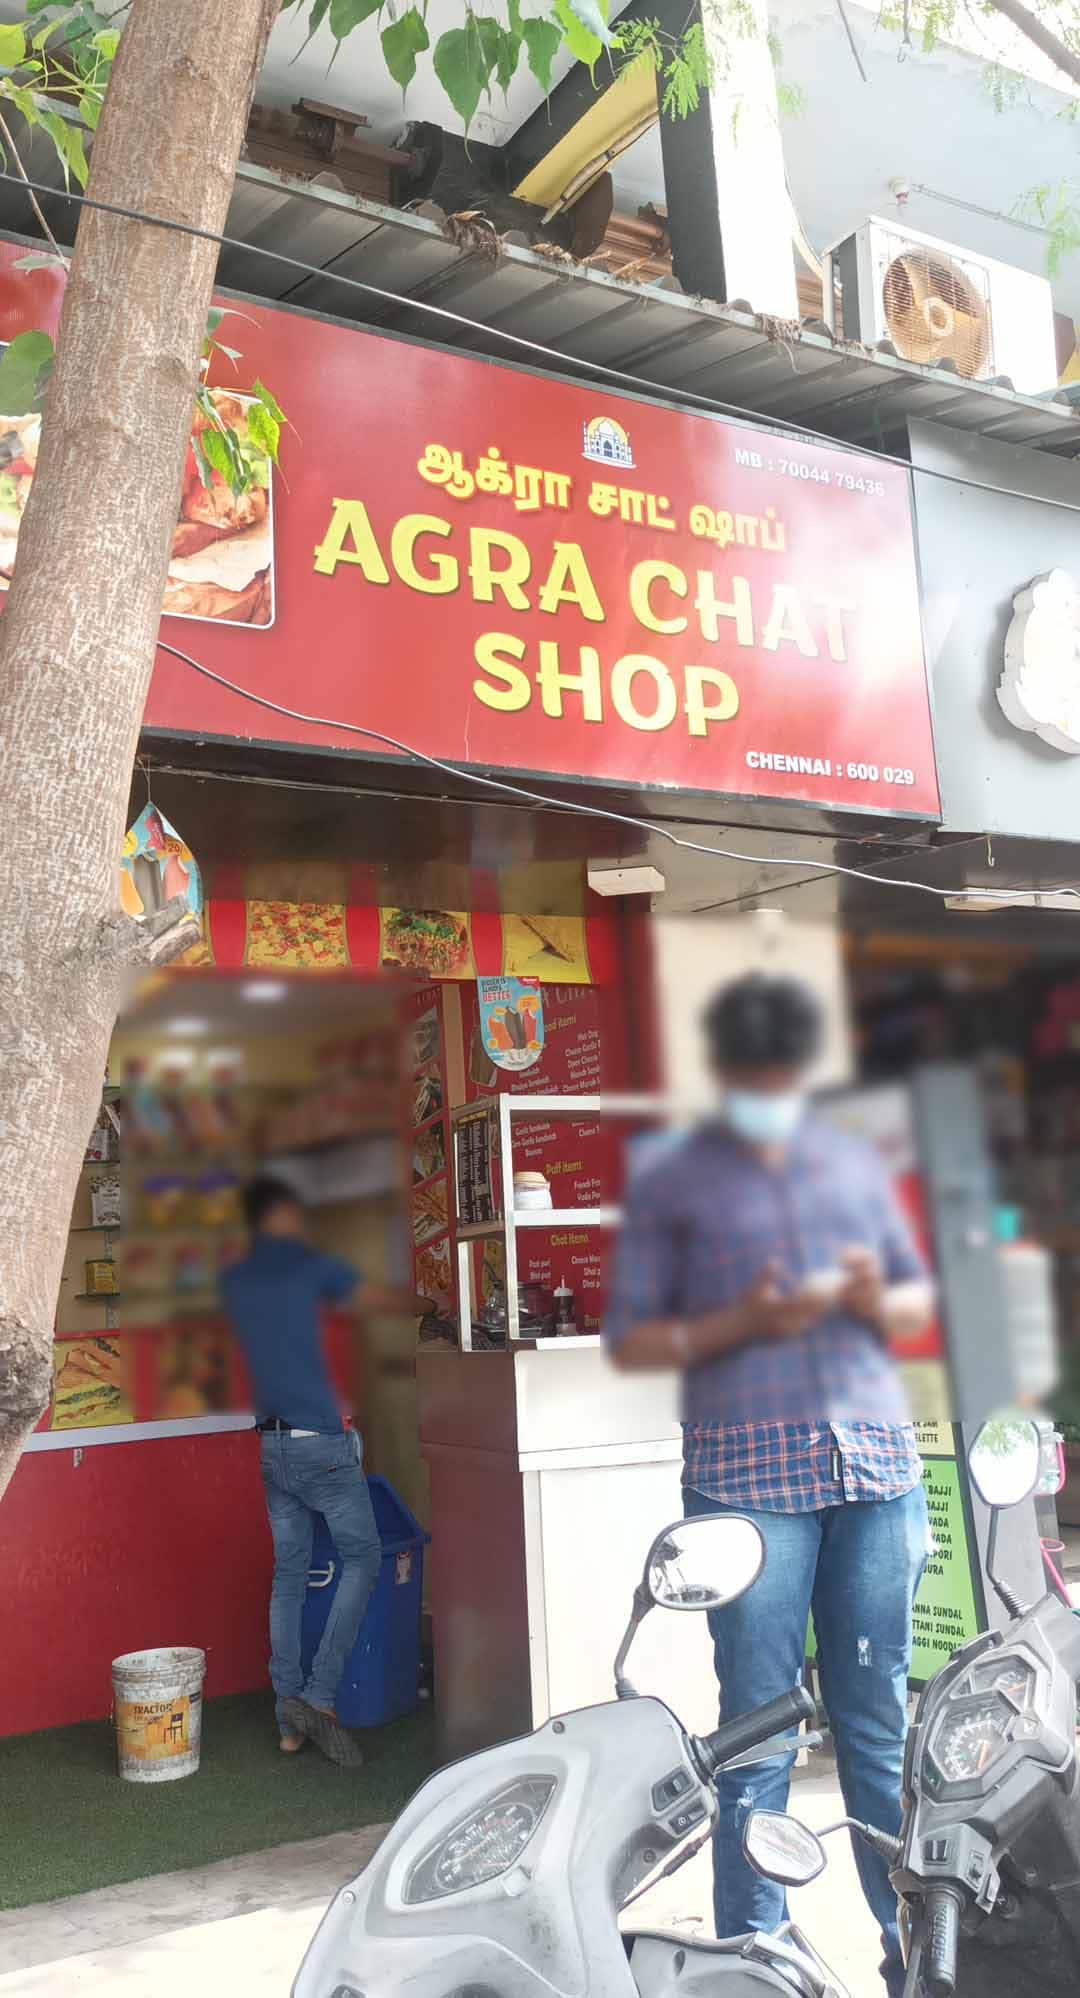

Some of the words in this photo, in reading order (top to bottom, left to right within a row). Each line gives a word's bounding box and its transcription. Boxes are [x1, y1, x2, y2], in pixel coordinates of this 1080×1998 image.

[735, 448, 762, 468] MB
[778, 459, 831, 484] 70044
[835, 472, 885, 496] 79436
[418, 441, 571, 512] ஆக்ரா
[588, 480, 676, 530] சாட்
[690, 502, 787, 552] ஷாப்
[313, 497, 606, 624] AGRA
[629, 559, 858, 664] CHAT
[473, 631, 740, 737] SHOP
[746, 751, 832, 777] CHENNAI
[847, 762, 879, 781] 600
[883, 767, 915, 785] 029
[927, 1484, 952, 1497] BAJJI
[932, 1605, 963, 1621] SUNDAL
[935, 1622, 966, 1638] SUNDAL
